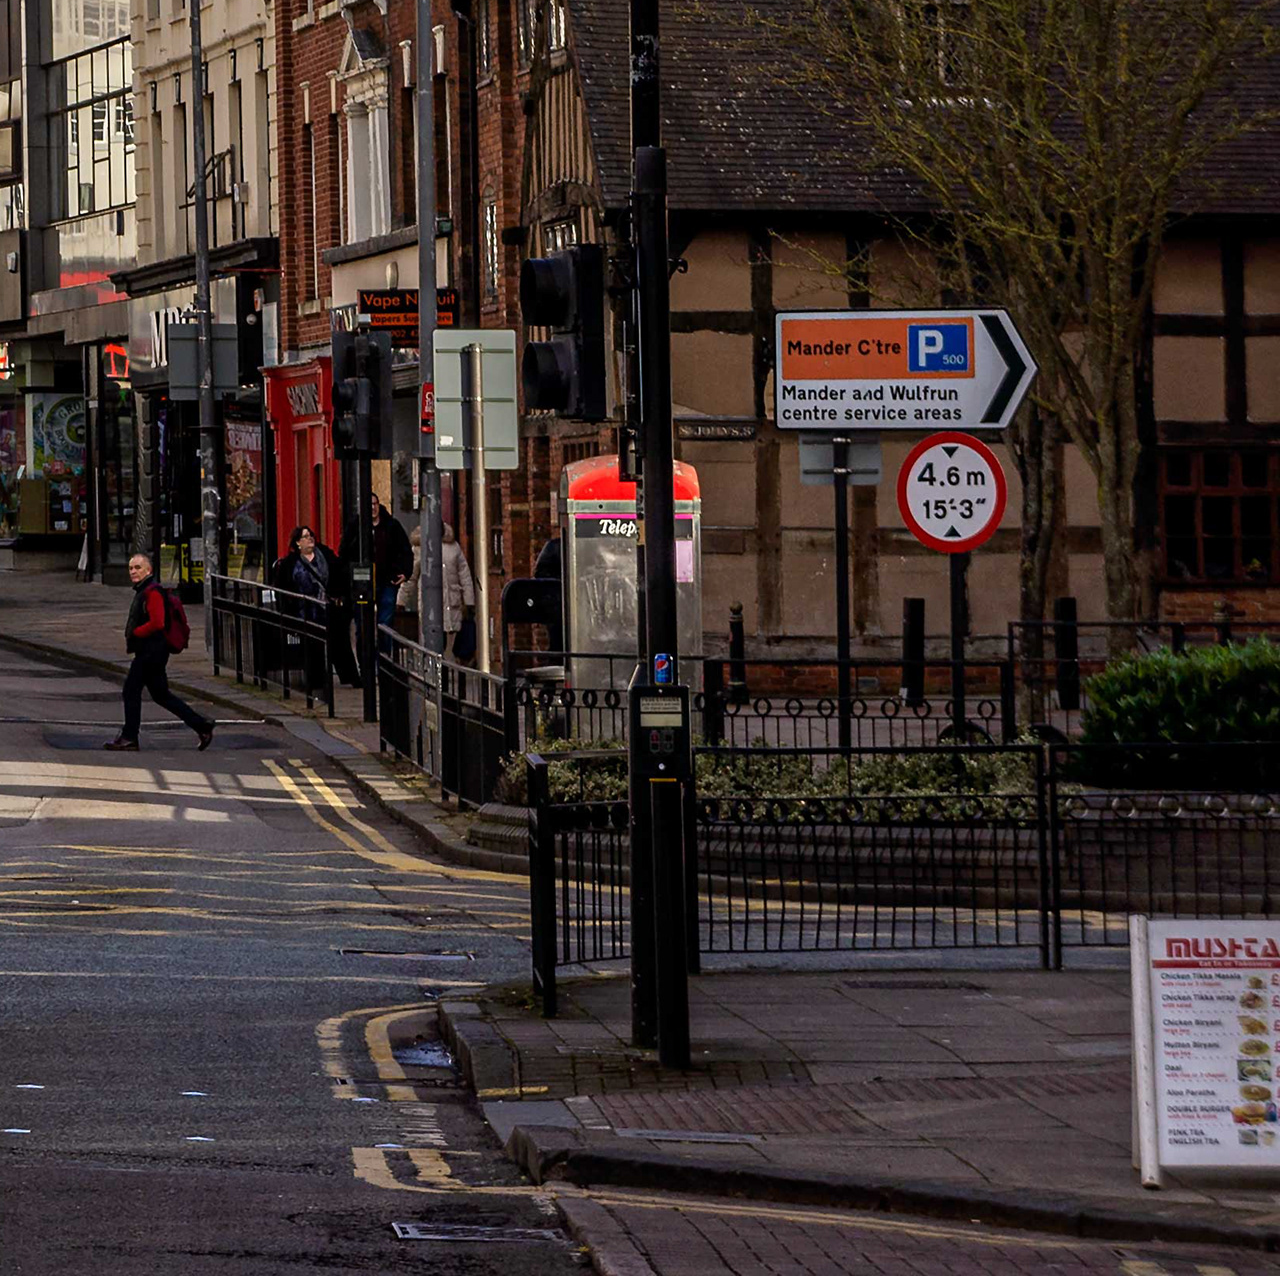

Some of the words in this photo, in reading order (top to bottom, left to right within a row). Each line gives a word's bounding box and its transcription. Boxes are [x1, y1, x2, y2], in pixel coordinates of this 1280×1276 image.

[363, 292, 400, 309] Vape
[787, 340, 851, 356] Mander
[857, 338, 901, 355] C'tre
[918, 330, 944, 367] P
[942, 354, 965, 365] 500
[782, 385, 846, 401] Mander
[852, 385, 884, 401] and
[889, 385, 959, 401] Wulfrun
[782, 406, 838, 421] centre
[844, 406, 907, 421] service
[914, 407, 962, 421] areas
[599, 518, 638, 535] Telep
[1161, 972, 1191, 980] Chicken
[1192, 972, 1213, 980] Tikka
[1195, 1019, 1223, 1027] Biryani
[1192, 1041, 1220, 1049] Biryani
[1167, 1105, 1198, 1113] DOUBLE
[1200, 1105, 1231, 1113] BURGER
[1168, 1137, 1203, 1145] ENGLISH
[1204, 1137, 1220, 1145] TEA
